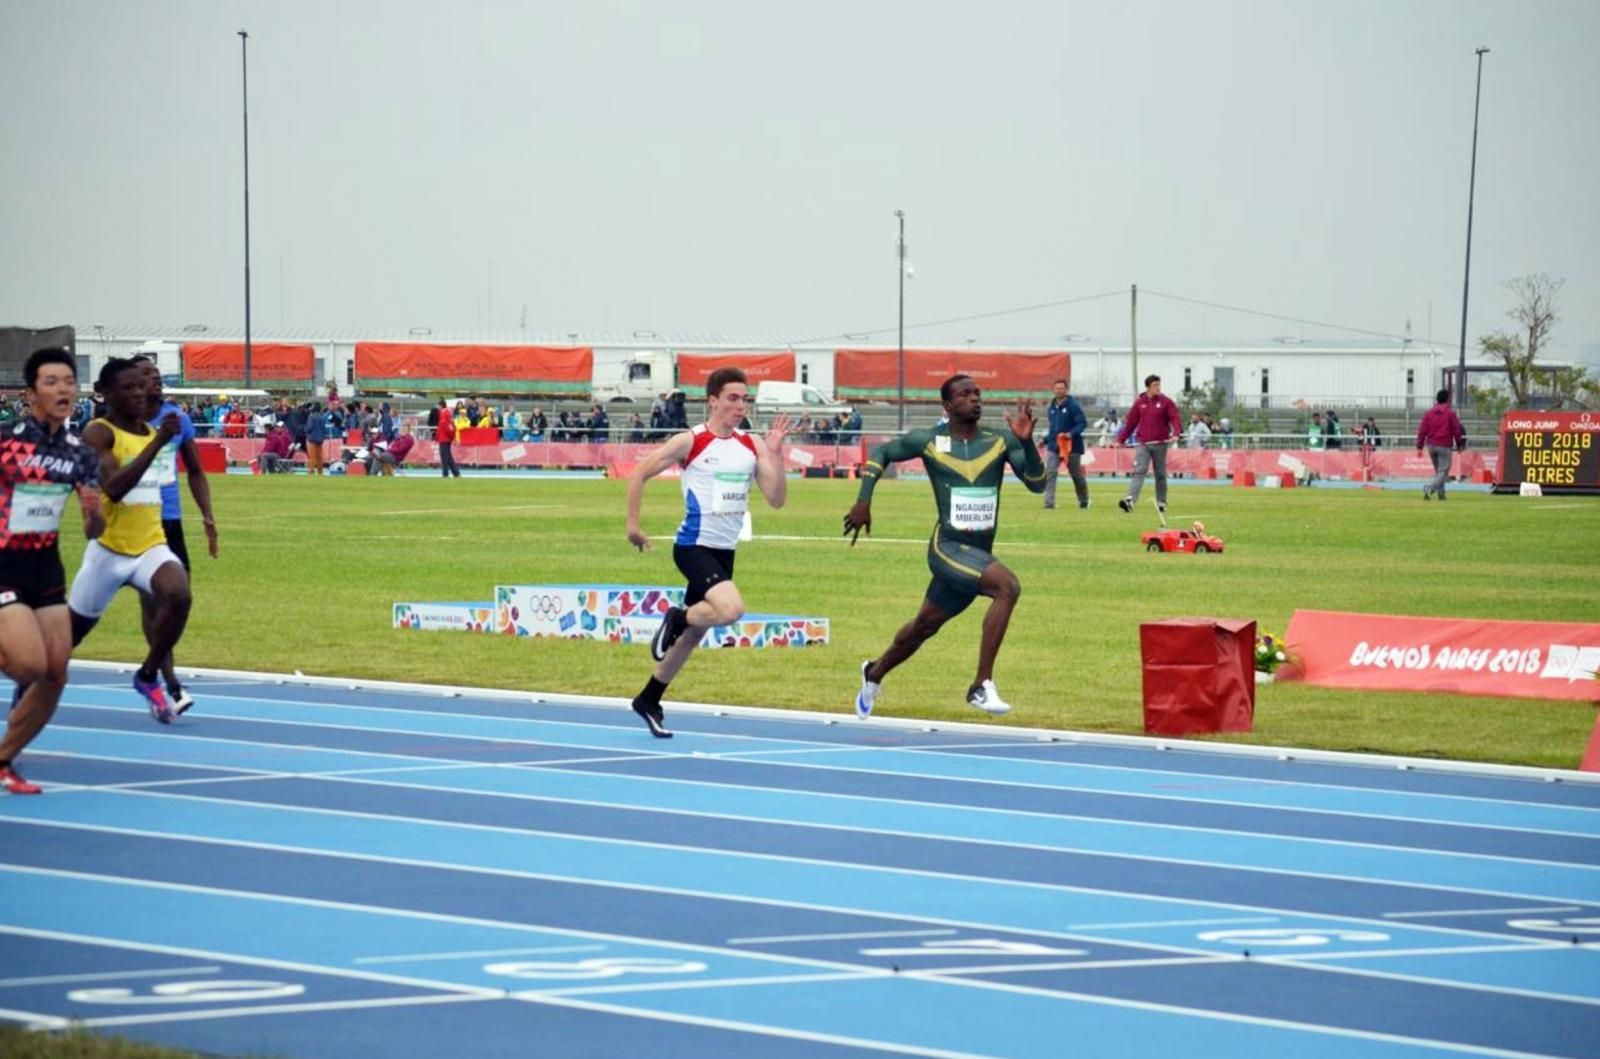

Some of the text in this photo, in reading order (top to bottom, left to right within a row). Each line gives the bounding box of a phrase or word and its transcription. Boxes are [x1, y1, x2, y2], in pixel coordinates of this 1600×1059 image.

[1507, 420, 1560, 429] LONG JUMP
[1514, 432, 1591, 448] YOG 2018
[17, 454, 75, 475] JAPAN
[1523, 450, 1581, 466] BUENOS
[1527, 467, 1575, 483] AIRES
[955, 512, 993, 522] MBERLINA
[1349, 641, 1541, 673] BUENOS AIRES 2018
[483, 958, 707, 980] 8
[67, 979, 306, 1005] 9
